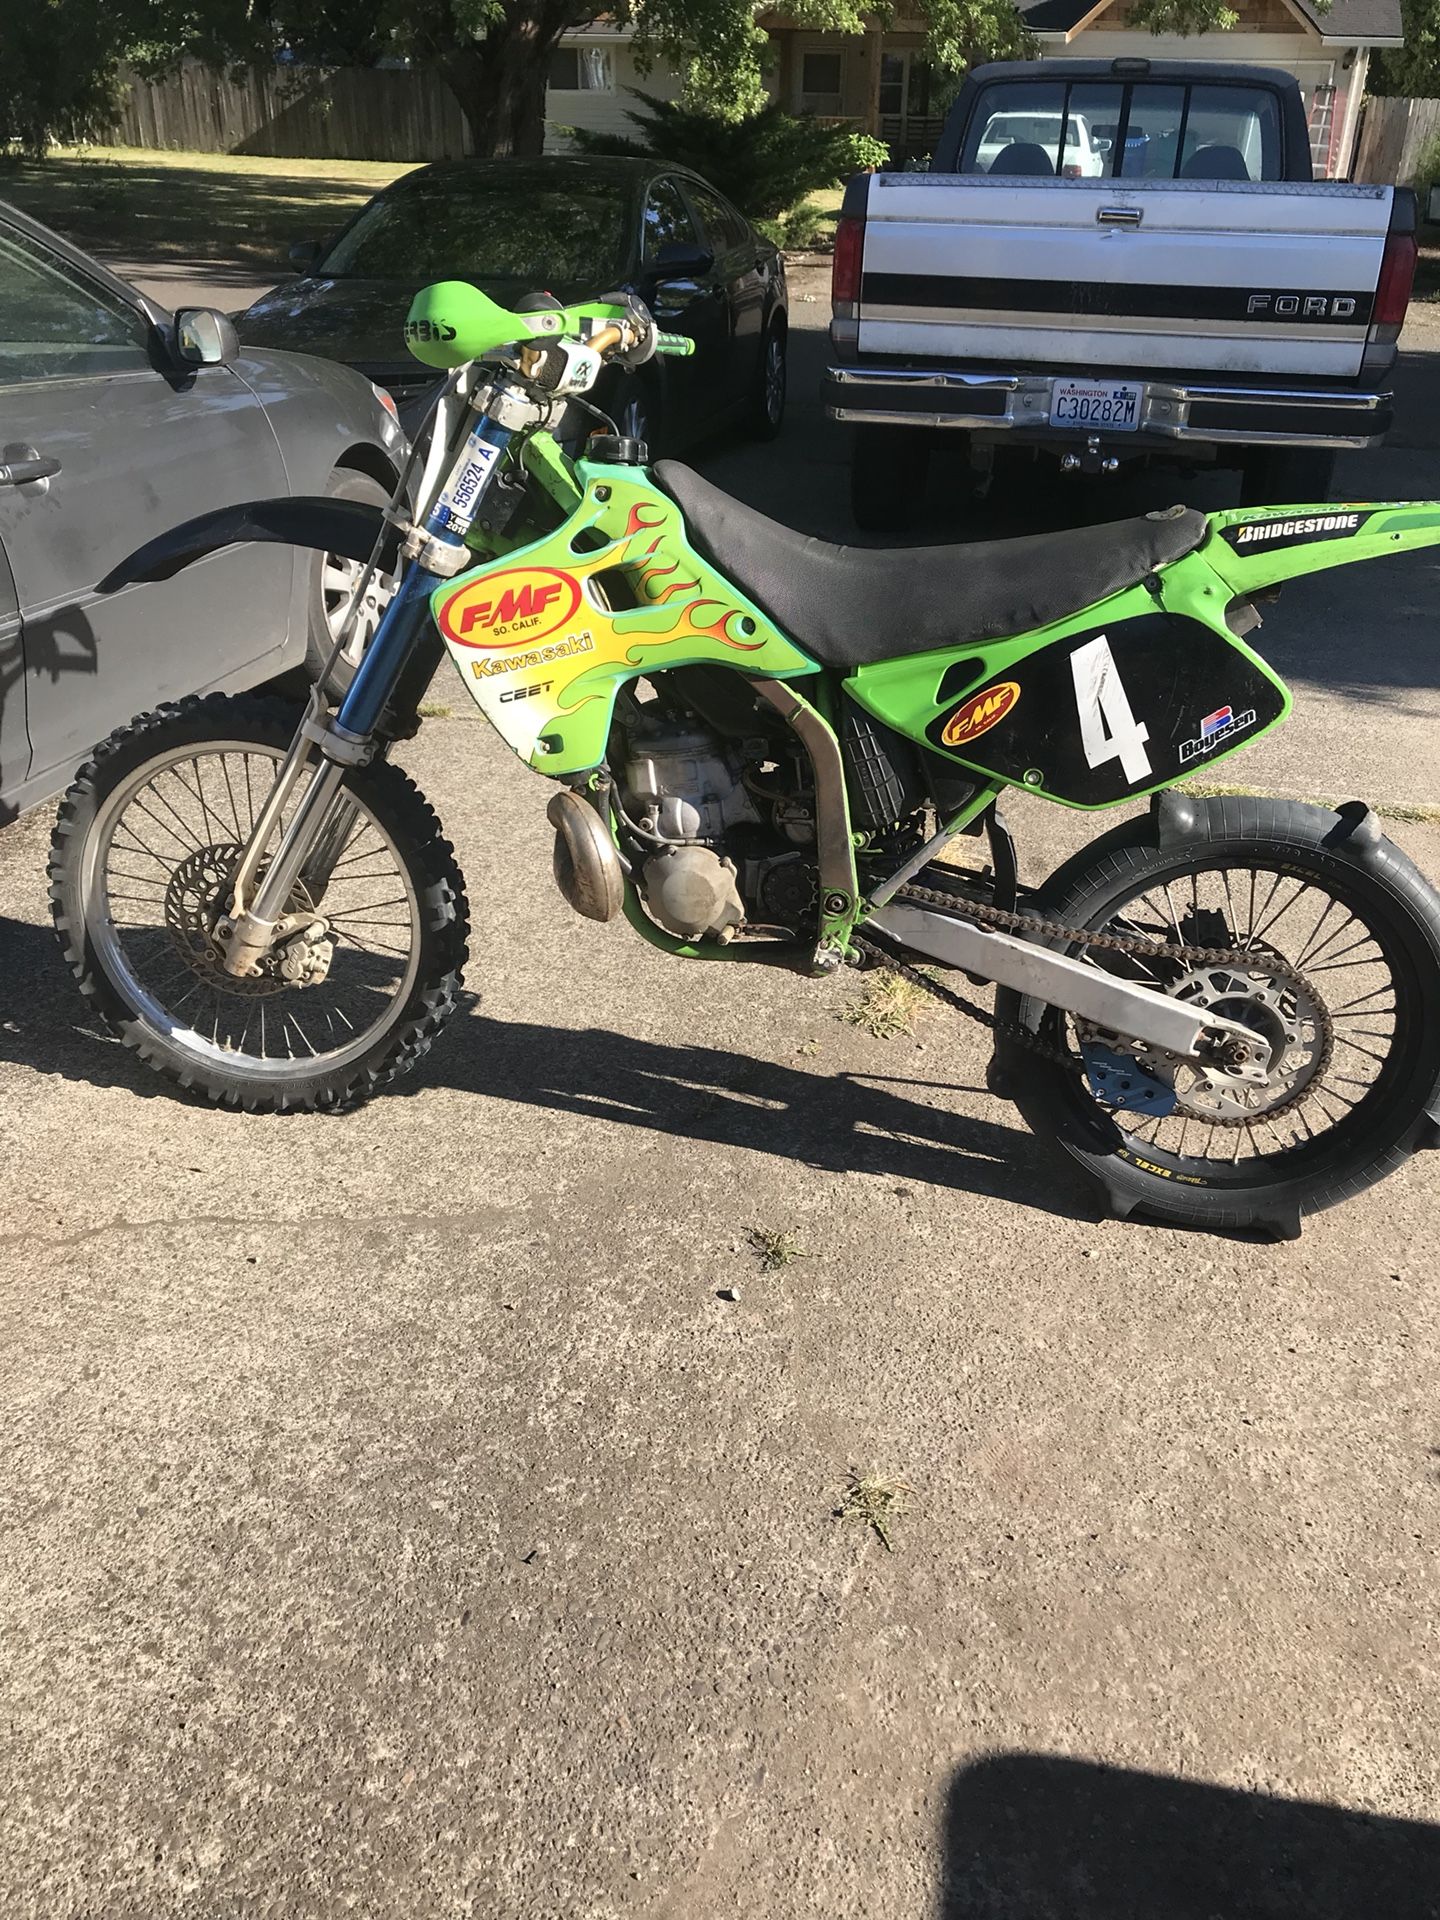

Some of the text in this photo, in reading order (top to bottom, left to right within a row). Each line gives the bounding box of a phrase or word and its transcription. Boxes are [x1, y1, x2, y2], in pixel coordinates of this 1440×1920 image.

[1247, 295, 1356, 316] FORD
[1060, 388, 1108, 398] WASHINGTON
[1057, 397, 1136, 423] C30282M
[452, 462, 485, 509] 556524
[478, 447, 494, 461] A
[445, 520, 468, 536] 2019
[1236, 514, 1359, 543] BRIDGESTONE
[460, 583, 562, 634] FMF
[493, 617, 542, 636] SO. CALIF.
[471, 632, 594, 679] Kawasaki
[499, 680, 555, 704] CEET
[952, 687, 1011, 742] FMF
[1070, 634, 1153, 785] 4
[1180, 709, 1256, 762] Boyesen
[1135, 1158, 1172, 1178] EXCEL
